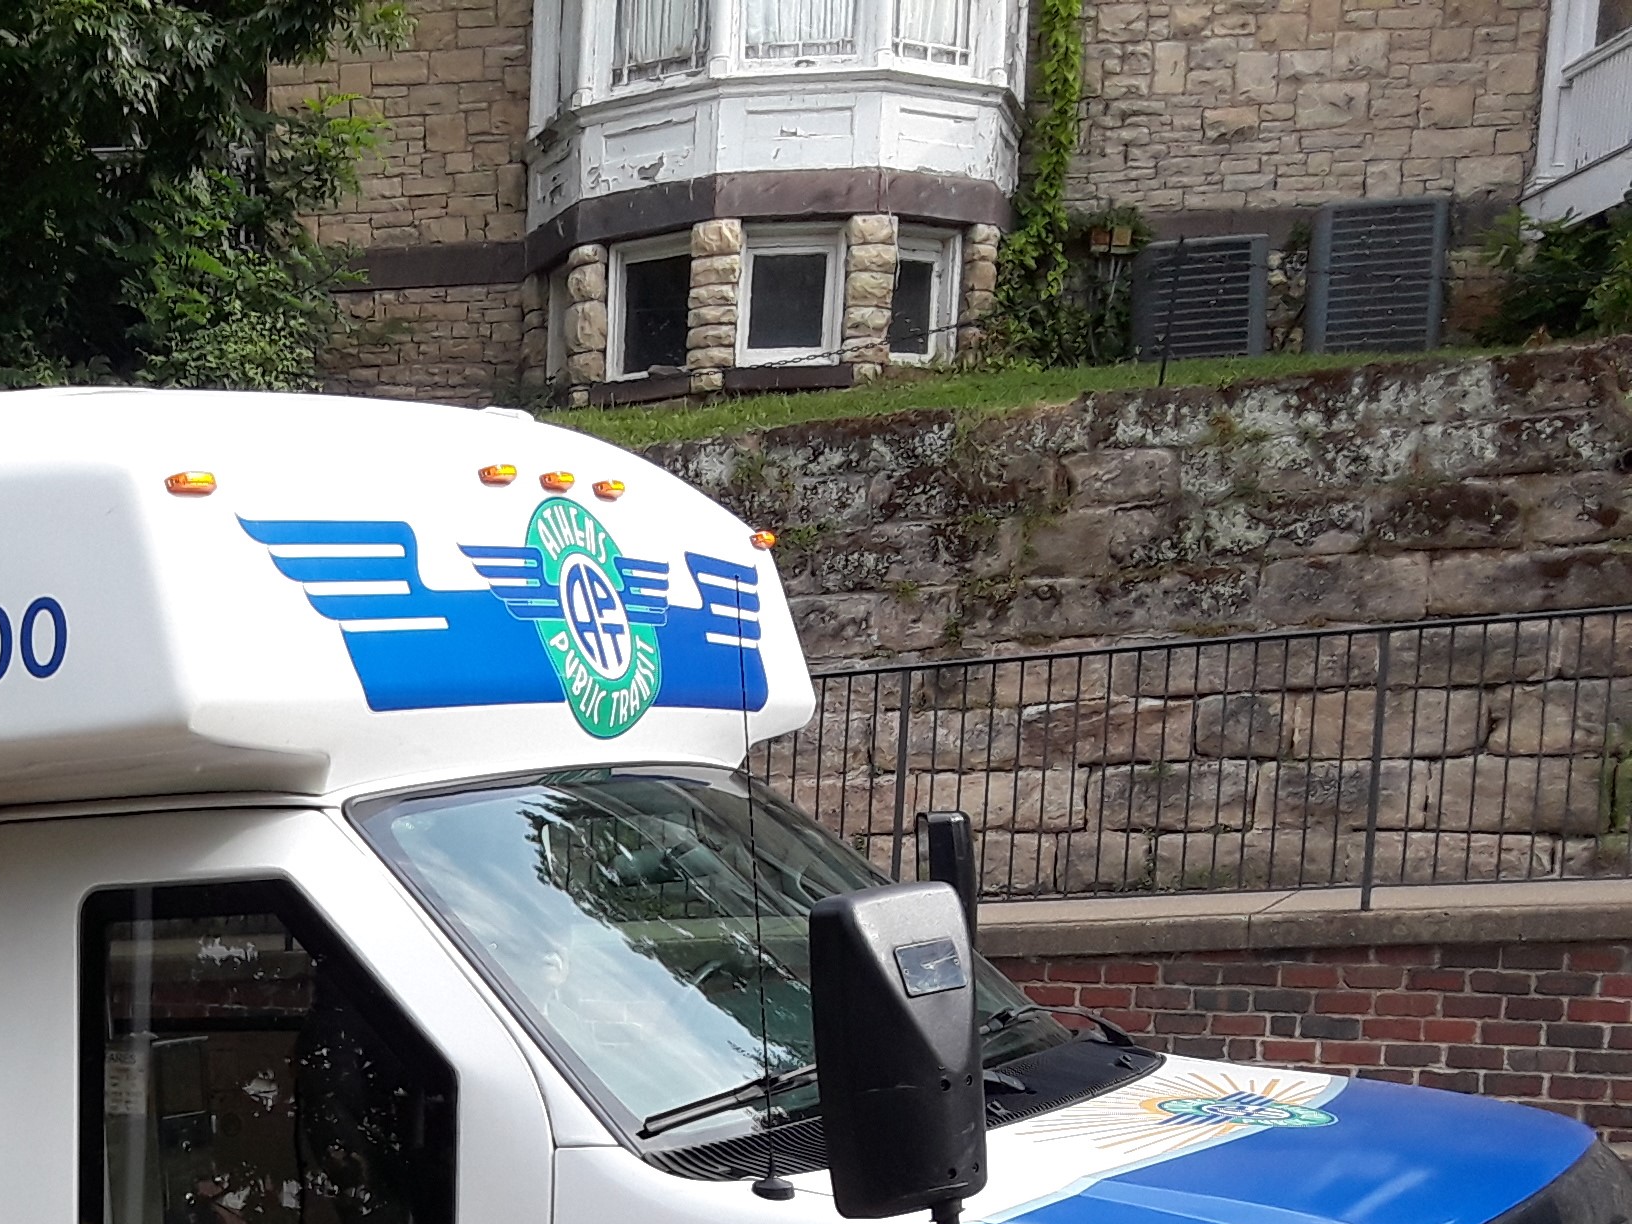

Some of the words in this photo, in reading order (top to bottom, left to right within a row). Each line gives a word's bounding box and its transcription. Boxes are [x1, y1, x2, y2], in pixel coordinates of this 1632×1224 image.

[537, 504, 607, 564] ATHENS
[549, 630, 608, 726] PUBLIC
[608, 634, 656, 729] TRANSIT
